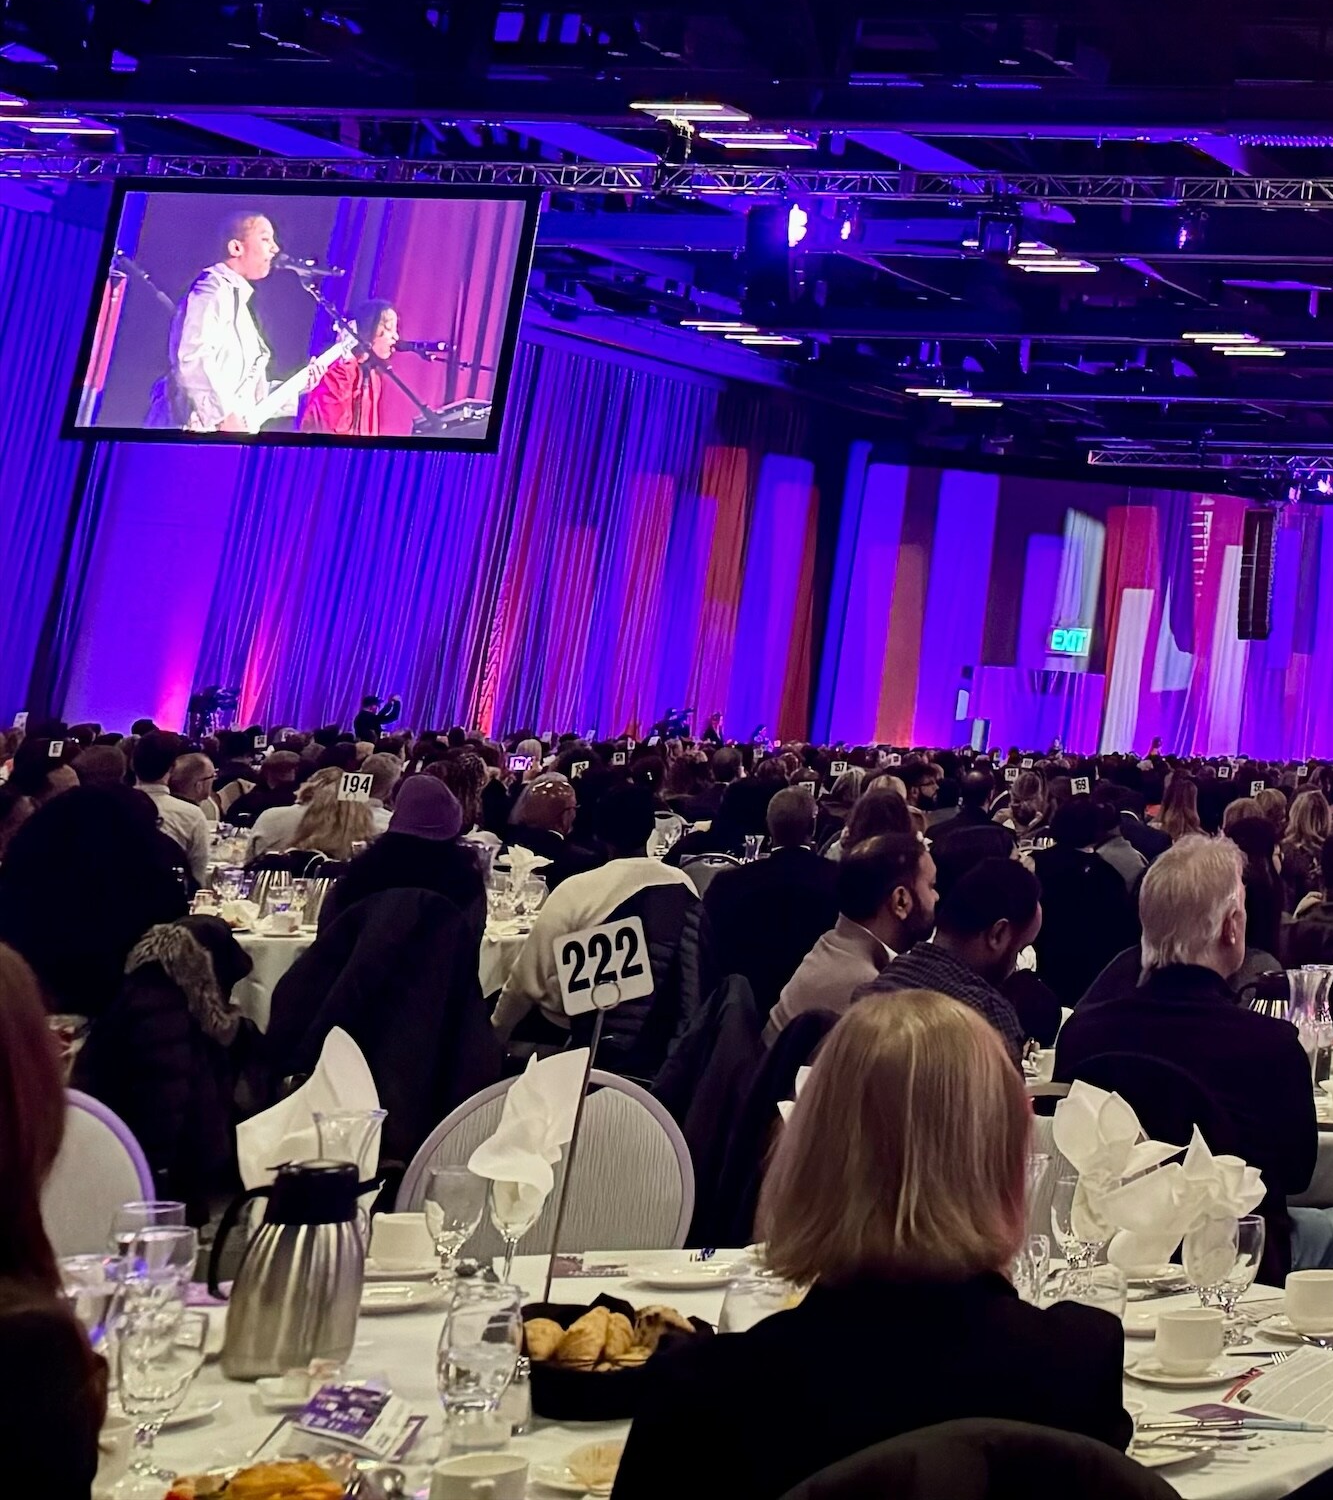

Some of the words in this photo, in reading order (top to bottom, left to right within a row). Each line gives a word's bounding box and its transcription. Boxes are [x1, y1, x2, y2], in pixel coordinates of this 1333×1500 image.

[1051, 629, 1088, 652] EXIT
[343, 774, 371, 794] 194
[562, 927, 643, 993] 222
